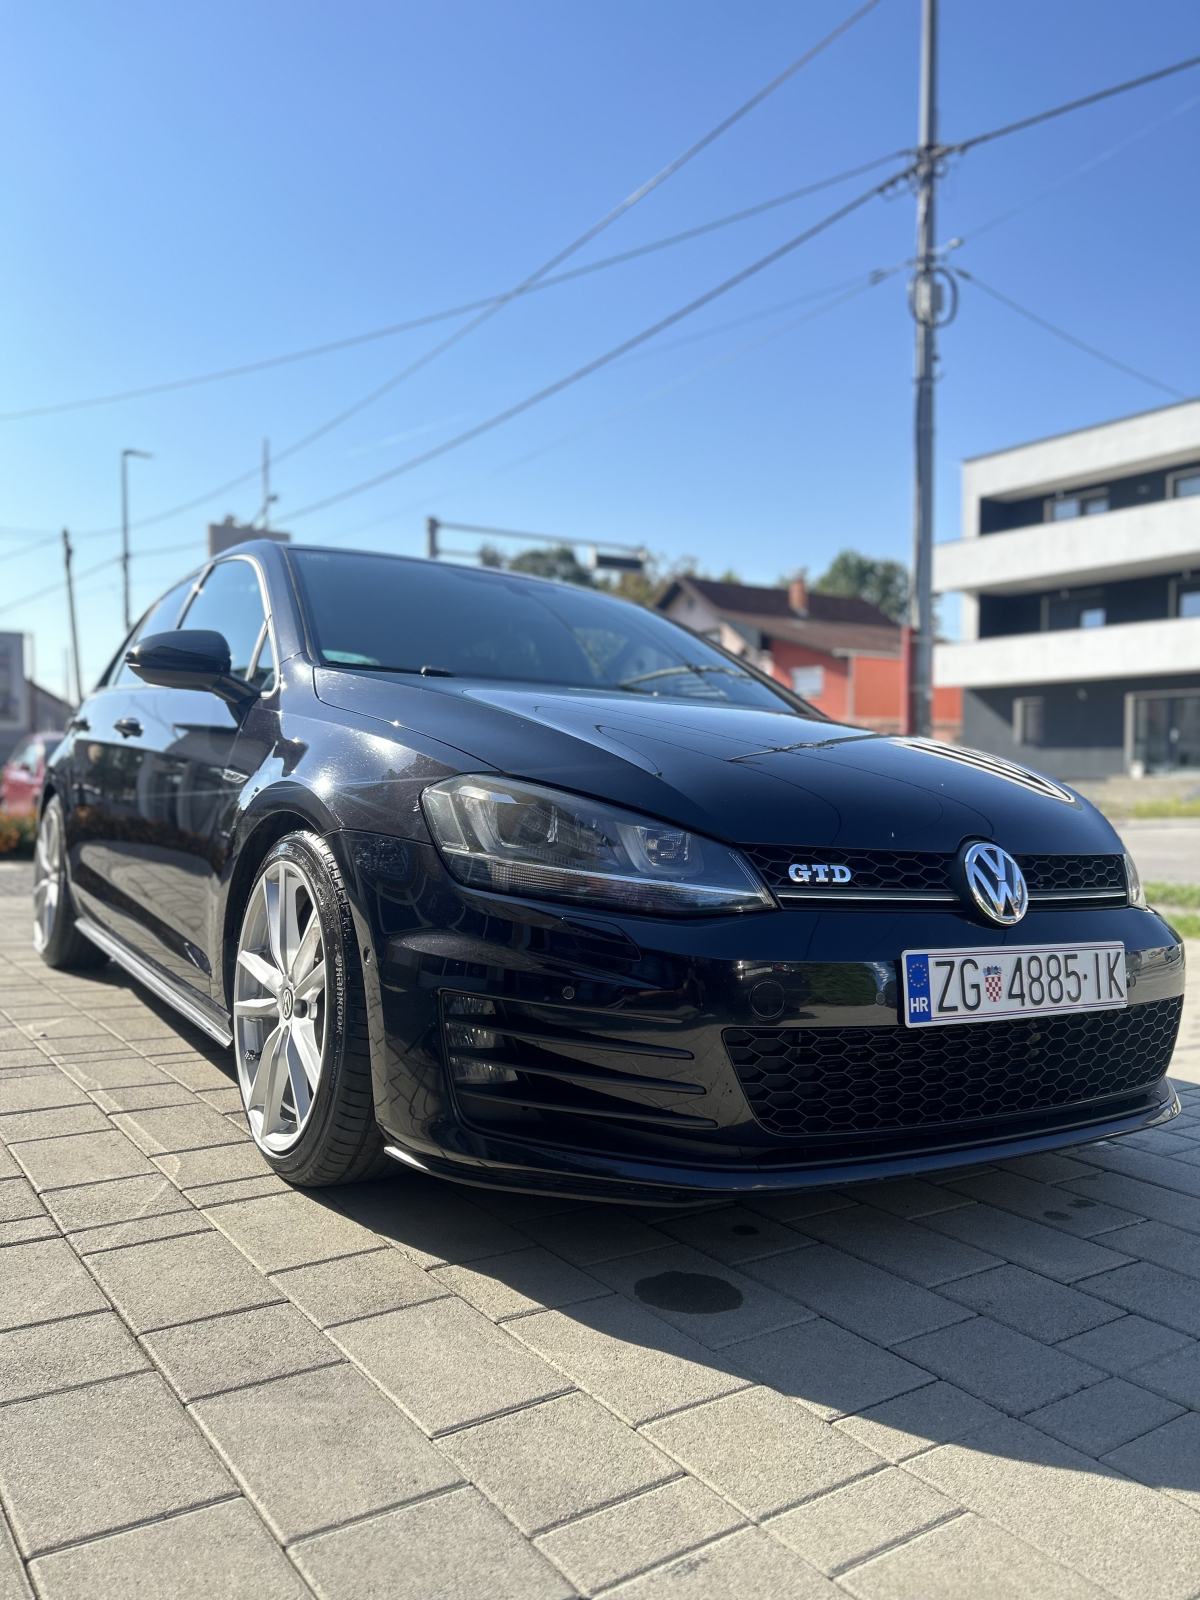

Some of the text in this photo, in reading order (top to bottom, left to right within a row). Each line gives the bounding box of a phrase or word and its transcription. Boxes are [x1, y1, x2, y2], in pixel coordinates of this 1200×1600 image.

[788, 863, 851, 883] GTD
[935, 958, 981, 1013] ZG
[910, 997, 929, 1014] HR
